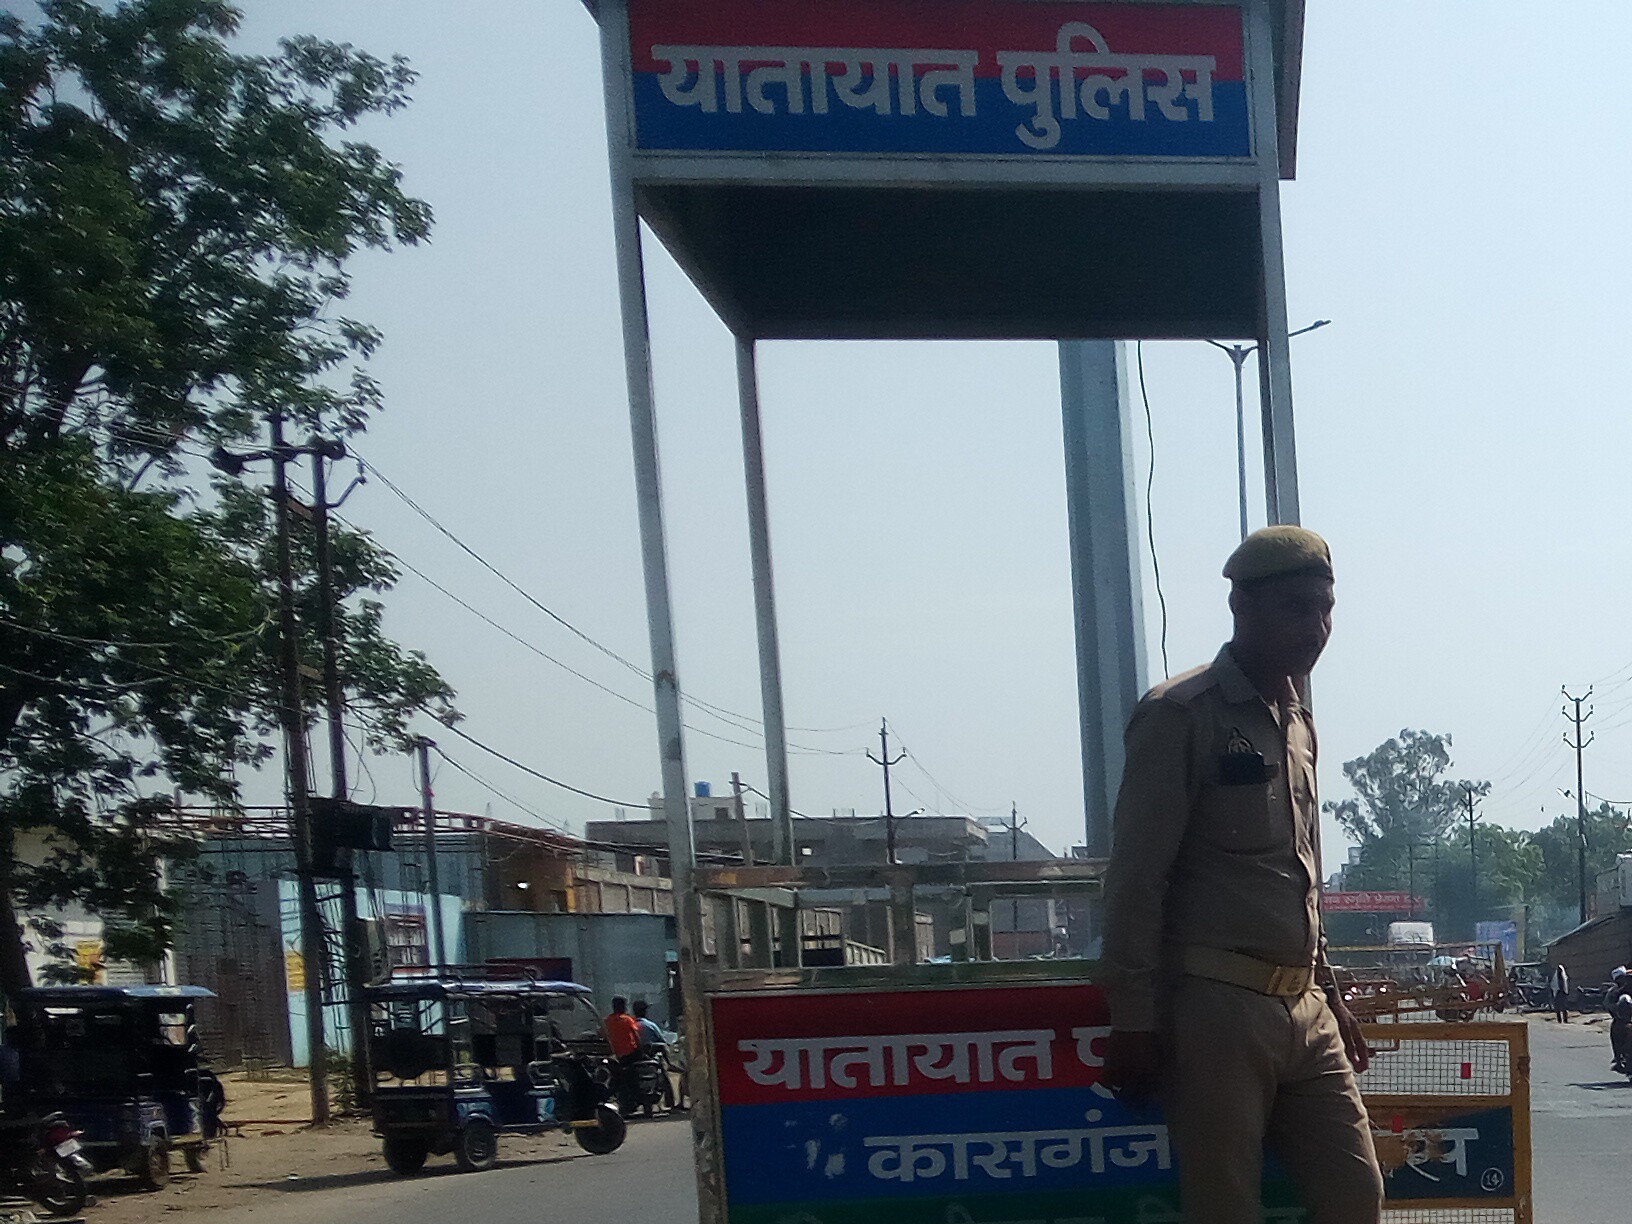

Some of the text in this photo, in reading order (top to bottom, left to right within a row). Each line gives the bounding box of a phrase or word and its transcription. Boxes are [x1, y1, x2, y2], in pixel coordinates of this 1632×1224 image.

[651, 20, 1216, 150] यातायात पुलिस
[737, 1028, 1056, 1090] यातायात
[863, 1107, 1173, 1183] कासगंज
